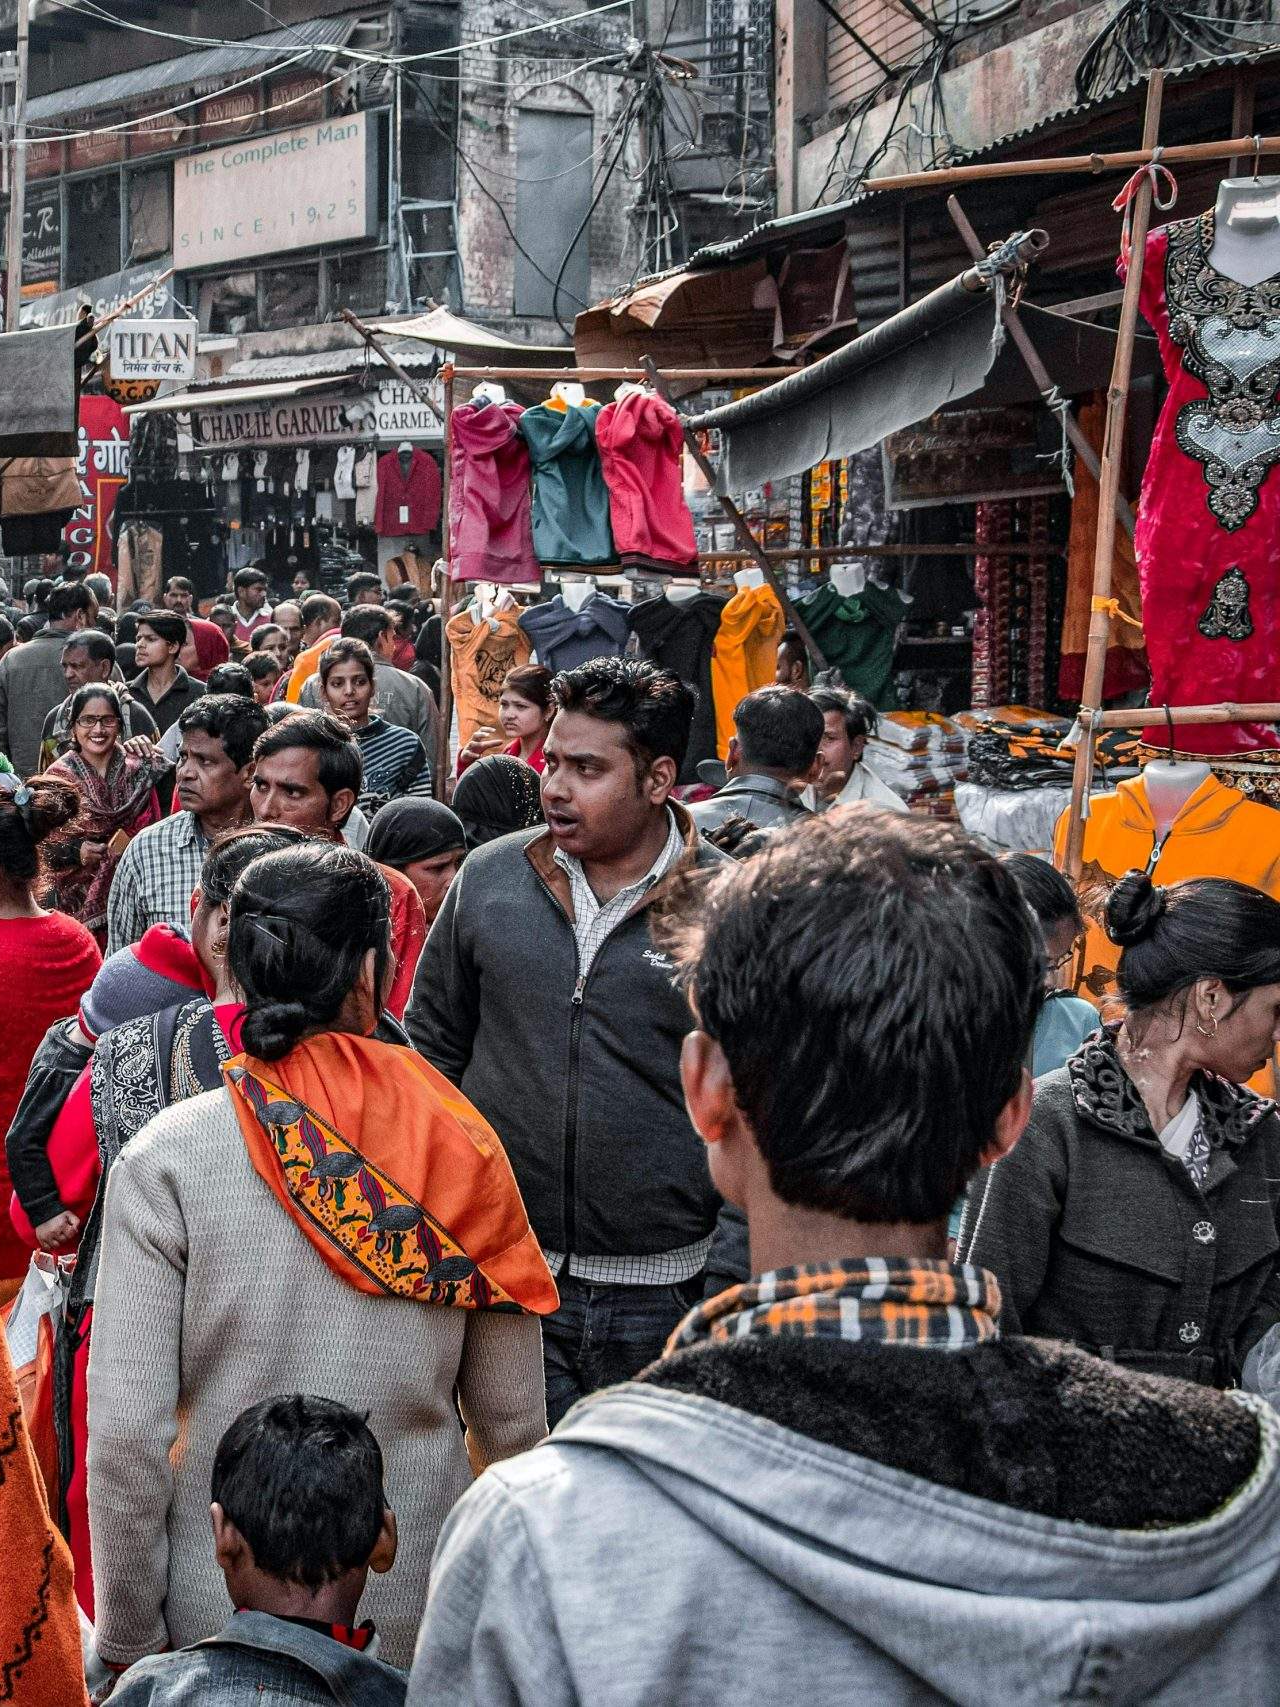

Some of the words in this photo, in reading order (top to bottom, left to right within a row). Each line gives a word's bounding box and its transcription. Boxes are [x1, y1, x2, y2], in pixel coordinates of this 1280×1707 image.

[184, 160, 215, 177] The
[221, 136, 309, 168] Complete
[317, 123, 358, 146] Man
[181, 218, 263, 247] SINCE
[290, 199, 357, 226] 1925
[115, 332, 192, 361] TITAN
[199, 410, 272, 443] CHARLIE
